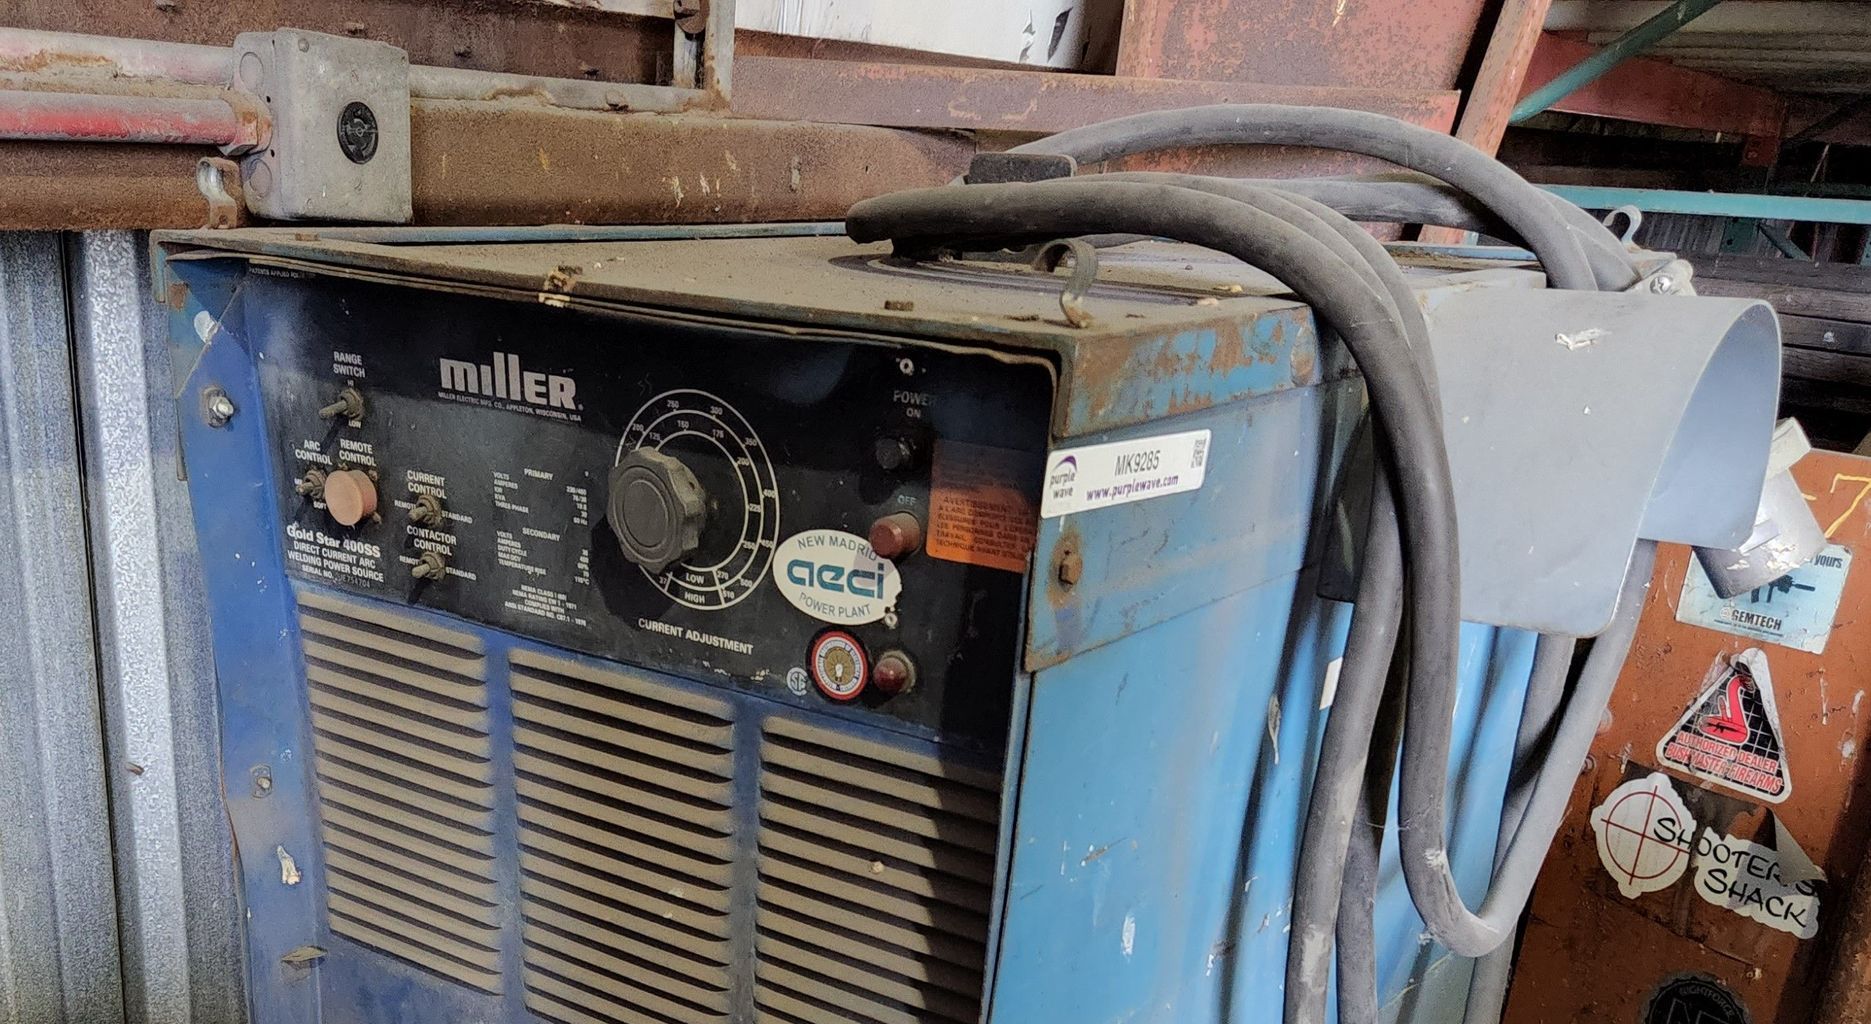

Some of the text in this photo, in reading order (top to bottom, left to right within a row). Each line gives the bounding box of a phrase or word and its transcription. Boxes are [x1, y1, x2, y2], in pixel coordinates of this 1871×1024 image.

[333, 350, 363, 366] RANGE
[332, 362, 367, 379] SWITCH
[438, 391, 456, 401] MILLER
[456, 395, 480, 406] ELECTRIC
[569, 413, 583, 423] USA
[893, 390, 938, 408] POWER
[905, 406, 922, 418] ON
[348, 419, 362, 429] LOW
[303, 439, 321, 452] ARC
[340, 437, 373, 455] REMOTE
[294, 447, 333, 467] CONTROL
[339, 450, 377, 468] CONTROL
[736, 456, 750, 467] 200
[1114, 450, 1161, 477] MK9285
[406, 469, 447, 488] CURRENT
[492, 470, 510, 481] VOLTS
[523, 467, 554, 481] PRIMARY
[1050, 467, 1076, 489] purple
[407, 481, 449, 500] CONTROL
[493, 478, 519, 490] AMPERES
[1053, 476, 1074, 500] wave
[1086, 474, 1180, 501] www.purplewave.com
[763, 487, 776, 499] 400
[896, 494, 917, 507] OFF
[494, 500, 512, 511] THREE
[511, 503, 529, 515] PHASE
[441, 510, 474, 525] STANDARD
[286, 524, 382, 559] Gold Star 400SS
[406, 524, 458, 547] CONTACTOR
[496, 530, 513, 540] VOLTS
[497, 537, 522, 549] AMPERES
[522, 526, 561, 543] SECONDARY
[293, 540, 376, 570] DIRECT CURRENT ARC
[413, 537, 453, 557] CONTROL
[497, 544, 511, 554] DUTY
[510, 547, 528, 558] CYCLE
[796, 535, 878, 562] NEW MADRID
[287, 549, 385, 583] WELDING POWER SOURCE
[301, 564, 322, 577] SERIAL
[399, 554, 477, 581] REMOT STANDARD
[497, 558, 534, 573] TEMPERATURE
[534, 566, 548, 577] RISE
[1814, 554, 1844, 570] yours
[685, 571, 706, 585] LOW
[717, 569, 729, 581] 270
[786, 558, 886, 601] aeci
[511, 588, 527, 599] NEMA
[527, 593, 548, 604] RATING
[520, 584, 537, 595] NEMA
[537, 588, 554, 599] CLASS
[684, 591, 707, 605] HIGH
[517, 603, 546, 617] STANDARD
[524, 599, 565, 615] COMPLIES WITH
[799, 591, 872, 620] POWER PLANT
[1731, 608, 1782, 631] GEMTECH
[637, 617, 755, 656] CURRENT ADJUSTMENT
[1675, 730, 1779, 774] AUTHORIZED DEALER
[1729, 761, 1783, 793] FIREARMS
[1703, 868, 1807, 928] SHACK
